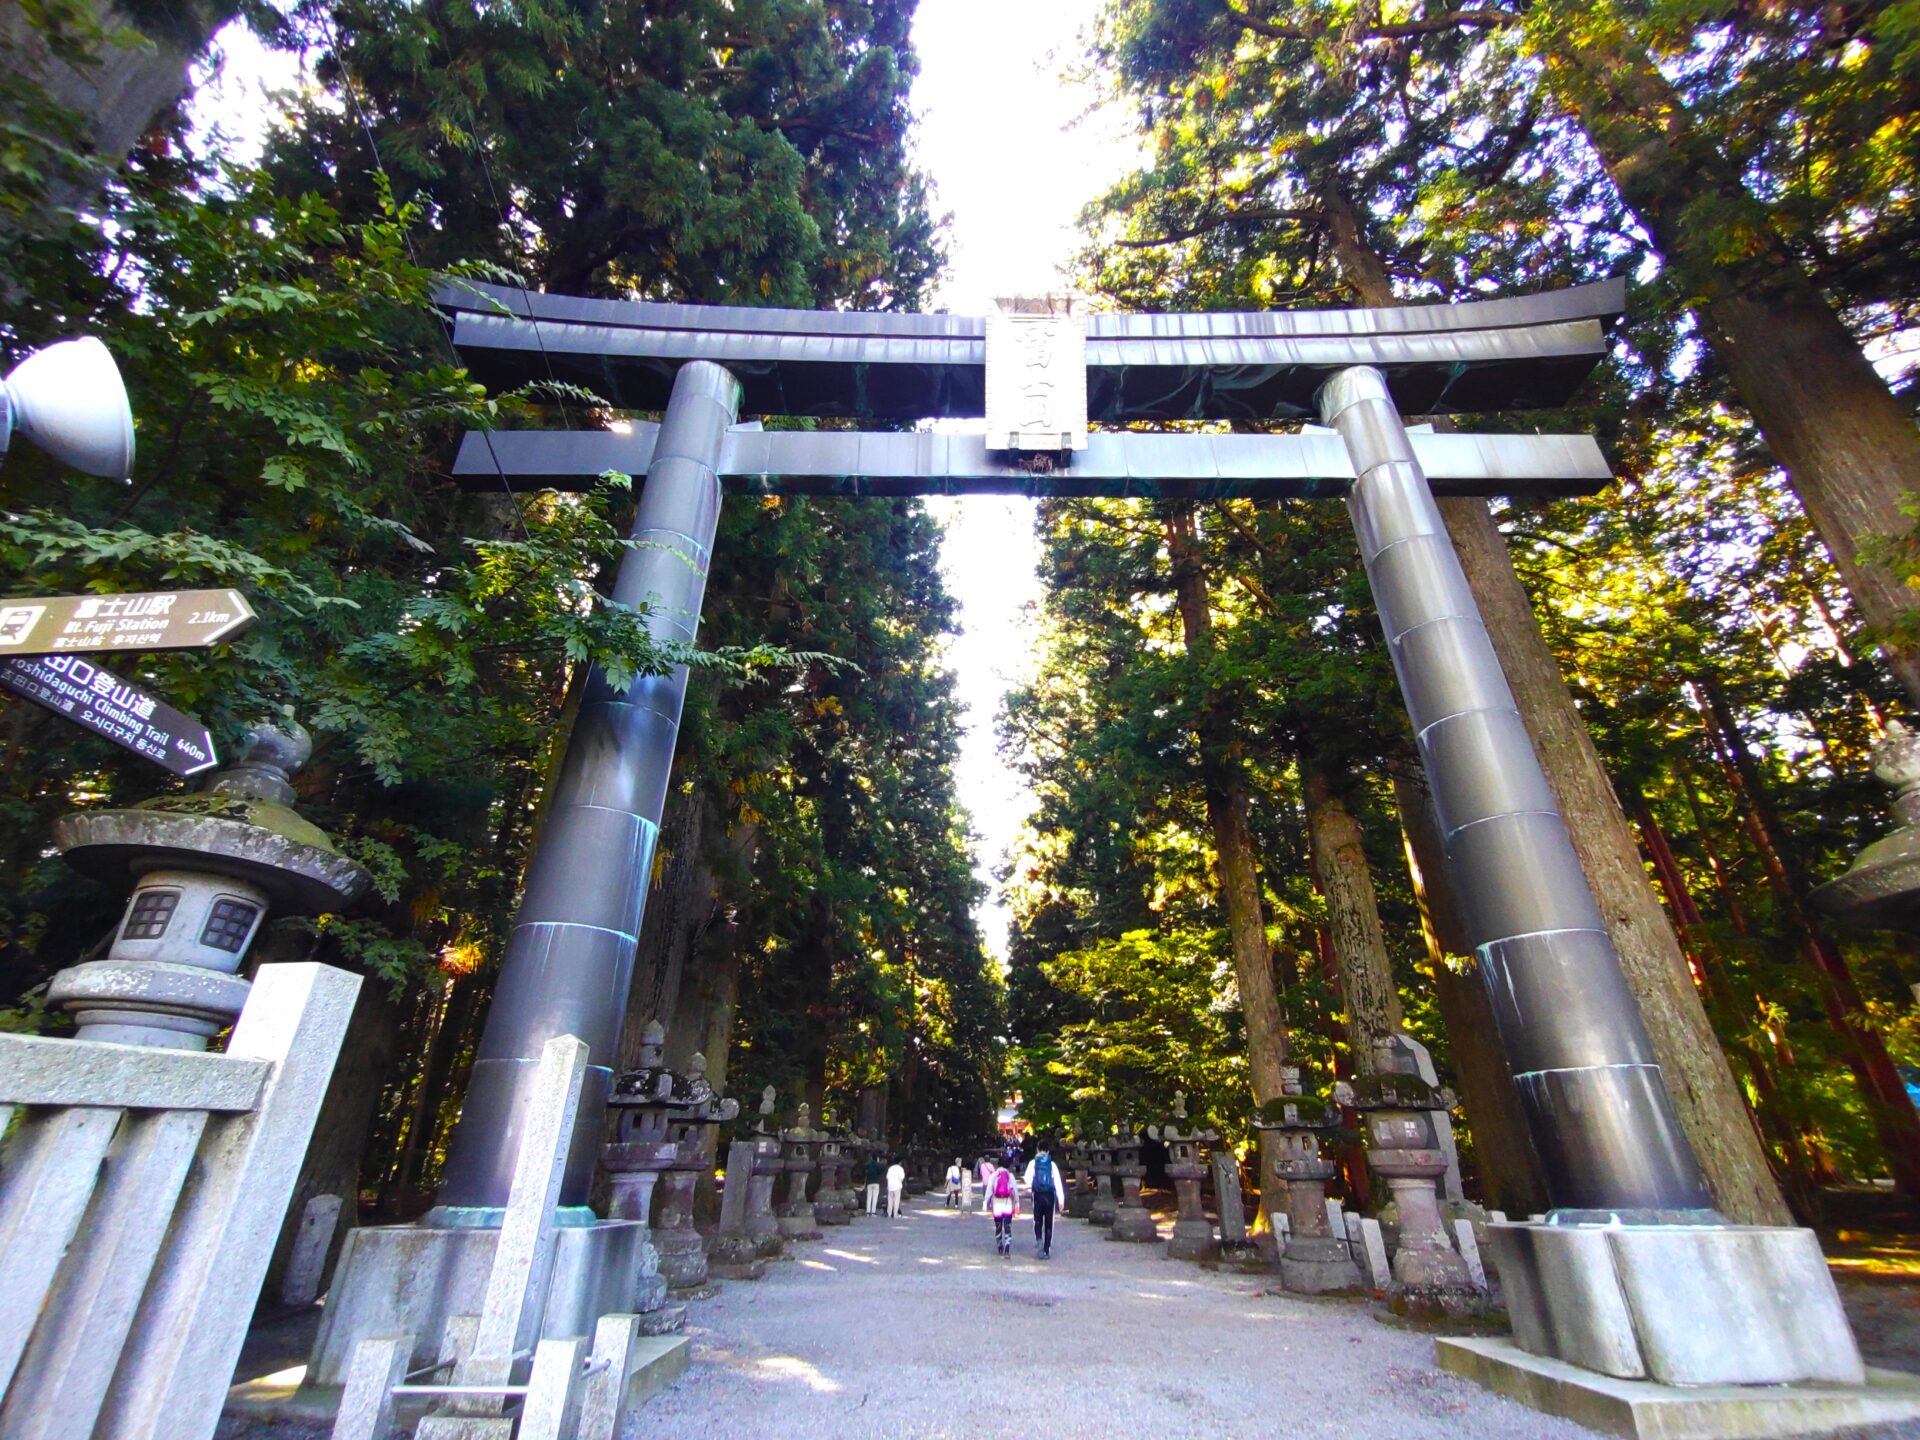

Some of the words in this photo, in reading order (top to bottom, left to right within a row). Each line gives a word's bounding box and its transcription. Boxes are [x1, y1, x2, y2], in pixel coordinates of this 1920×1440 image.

[73, 594, 177, 618] 富士山駅
[187, 611, 230, 625] 2.1km
[63, 621, 82, 634] Mt.
[84, 619, 114, 635] Fuji
[115, 617, 169, 632] Station
[43, 655, 157, 720] 田口登山道
[80, 709, 135, 744] 요시다구치
[94, 698, 144, 734] Climbing
[145, 724, 169, 746] Trail
[176, 738, 205, 761] 440m
